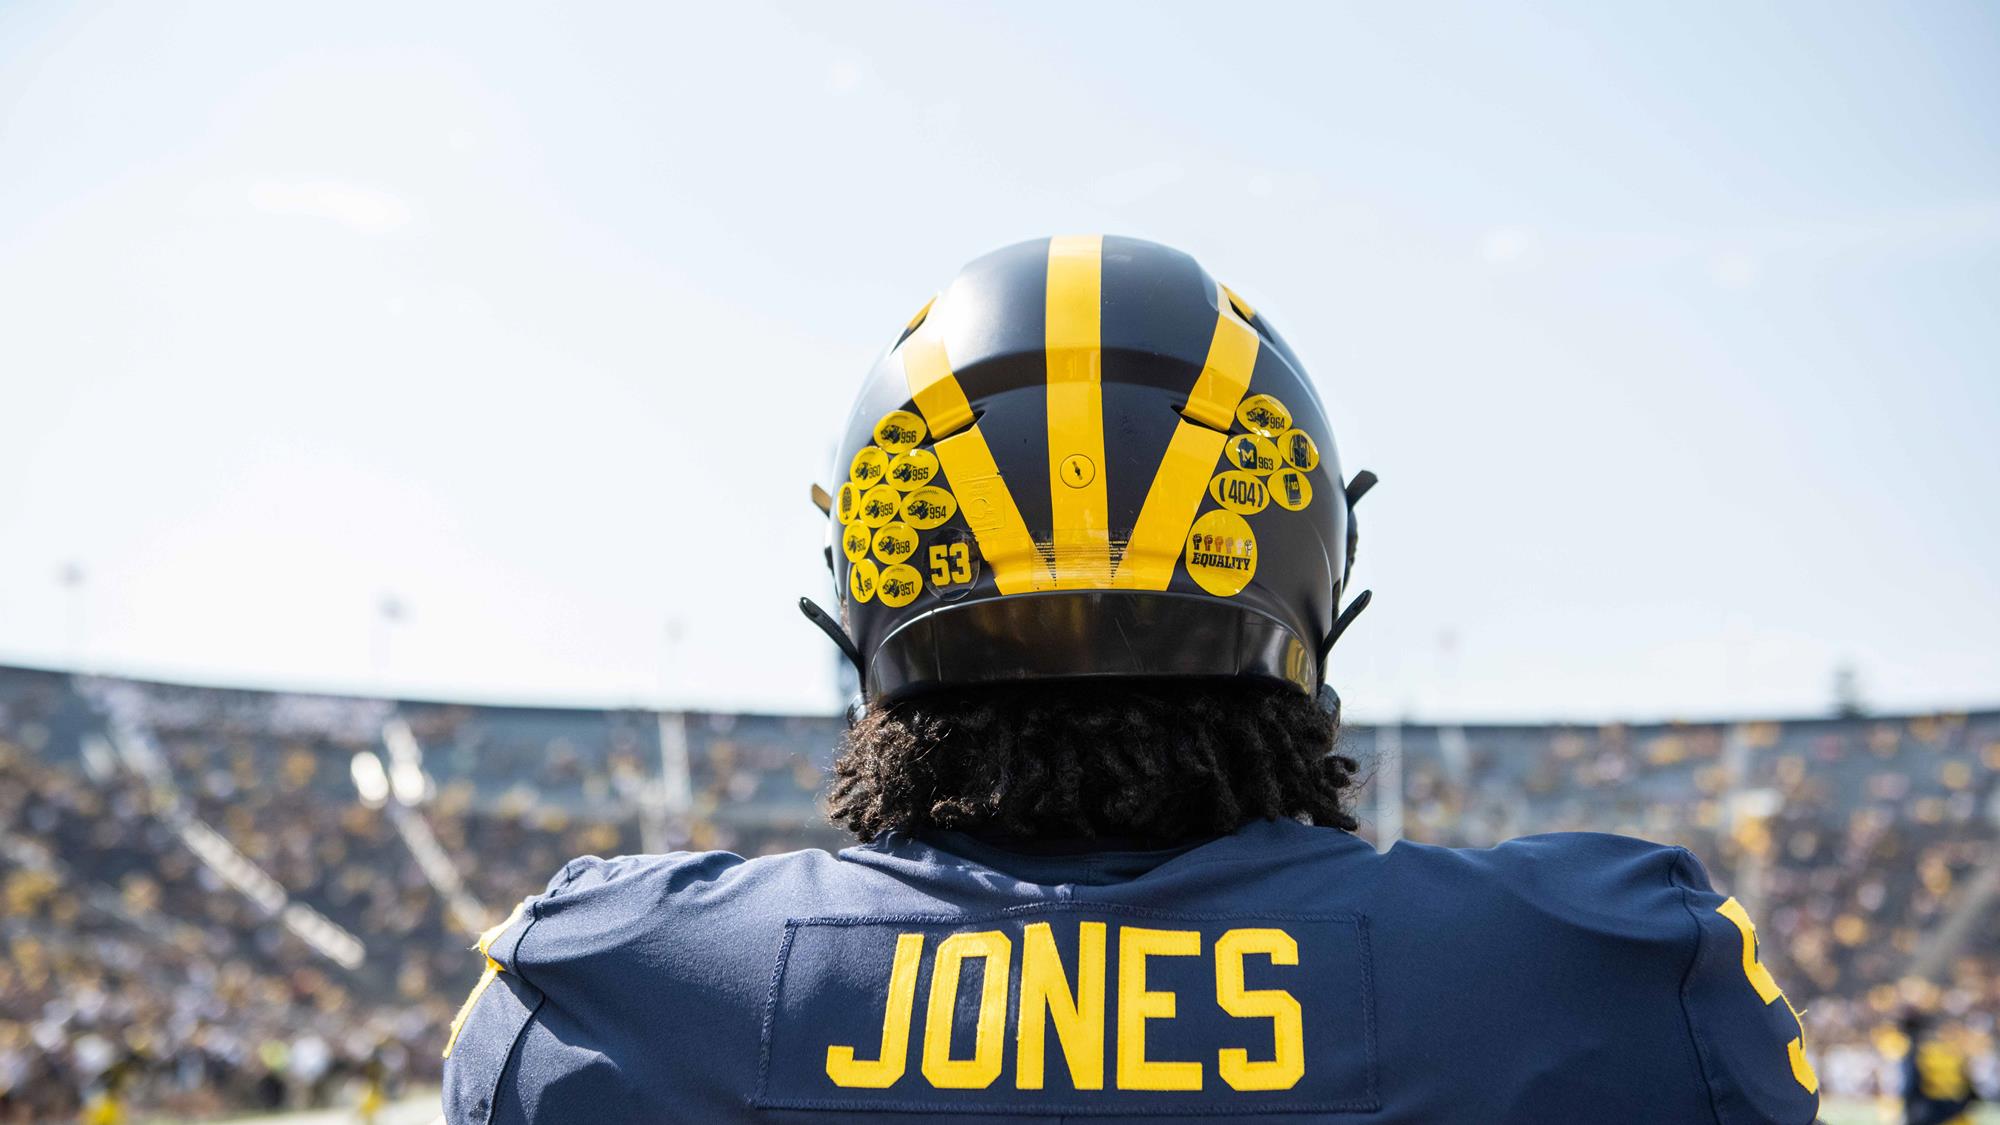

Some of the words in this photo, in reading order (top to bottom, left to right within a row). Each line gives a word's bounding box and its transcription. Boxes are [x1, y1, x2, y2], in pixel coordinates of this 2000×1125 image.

[1269, 416, 1285, 430] 964
[900, 430, 917, 443] 956
[1241, 449, 1255, 463] M
[1258, 456, 1274, 471] 963
[911, 467, 929, 481] 955
[880, 502, 894, 517] 959
[929, 505, 947, 519] 954
[895, 541, 910, 555] 958
[929, 542, 972, 587] 53
[1191, 552, 1251, 571] EQUALITY
[900, 581, 915, 596] 957
[826, 921, 1305, 1092] JONES
